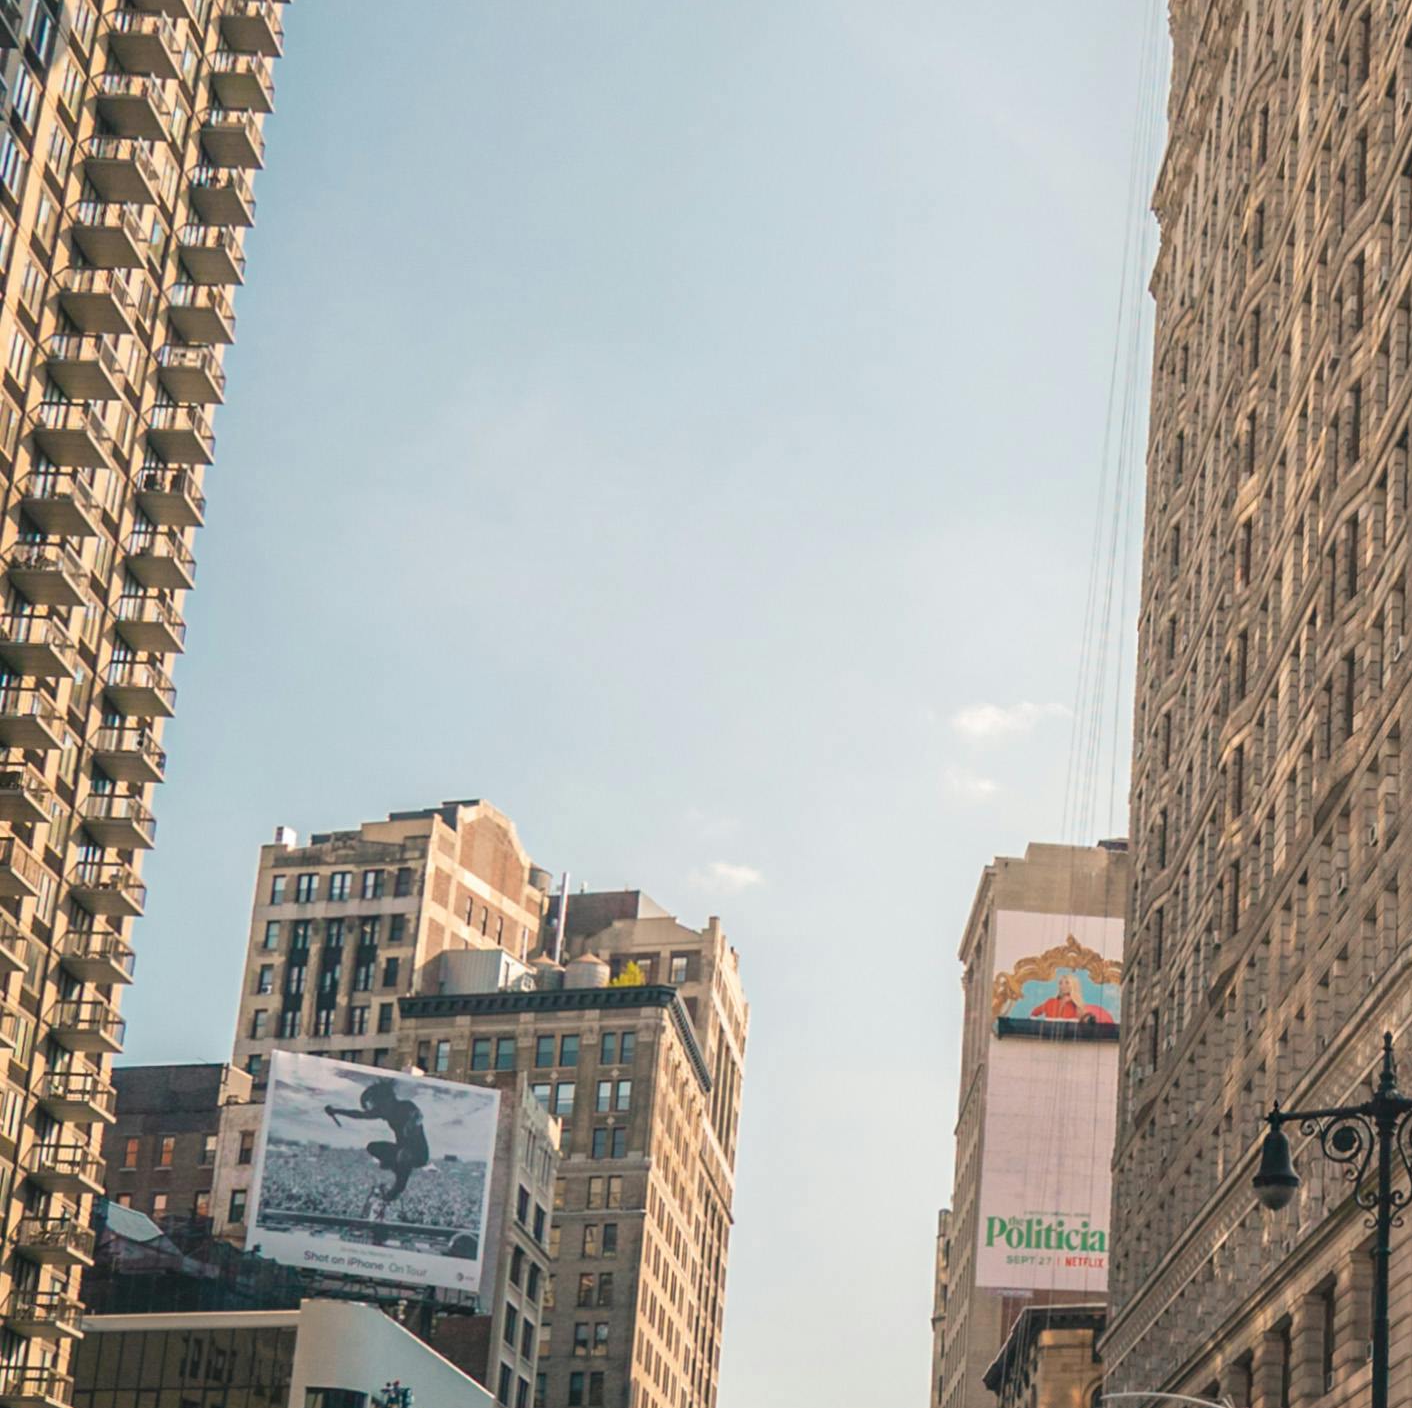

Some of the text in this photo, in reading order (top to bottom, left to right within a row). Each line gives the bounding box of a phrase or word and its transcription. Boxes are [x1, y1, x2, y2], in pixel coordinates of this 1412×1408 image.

[985, 1216, 1105, 1252] Politicia
[303, 1249, 329, 1264] Shot
[331, 1255, 345, 1265] on
[347, 1257, 385, 1272] iPhone
[388, 1262, 404, 1274] On
[405, 1263, 429, 1277] Tour
[1006, 1255, 1104, 1268] SEPT 27 NETFLIX
